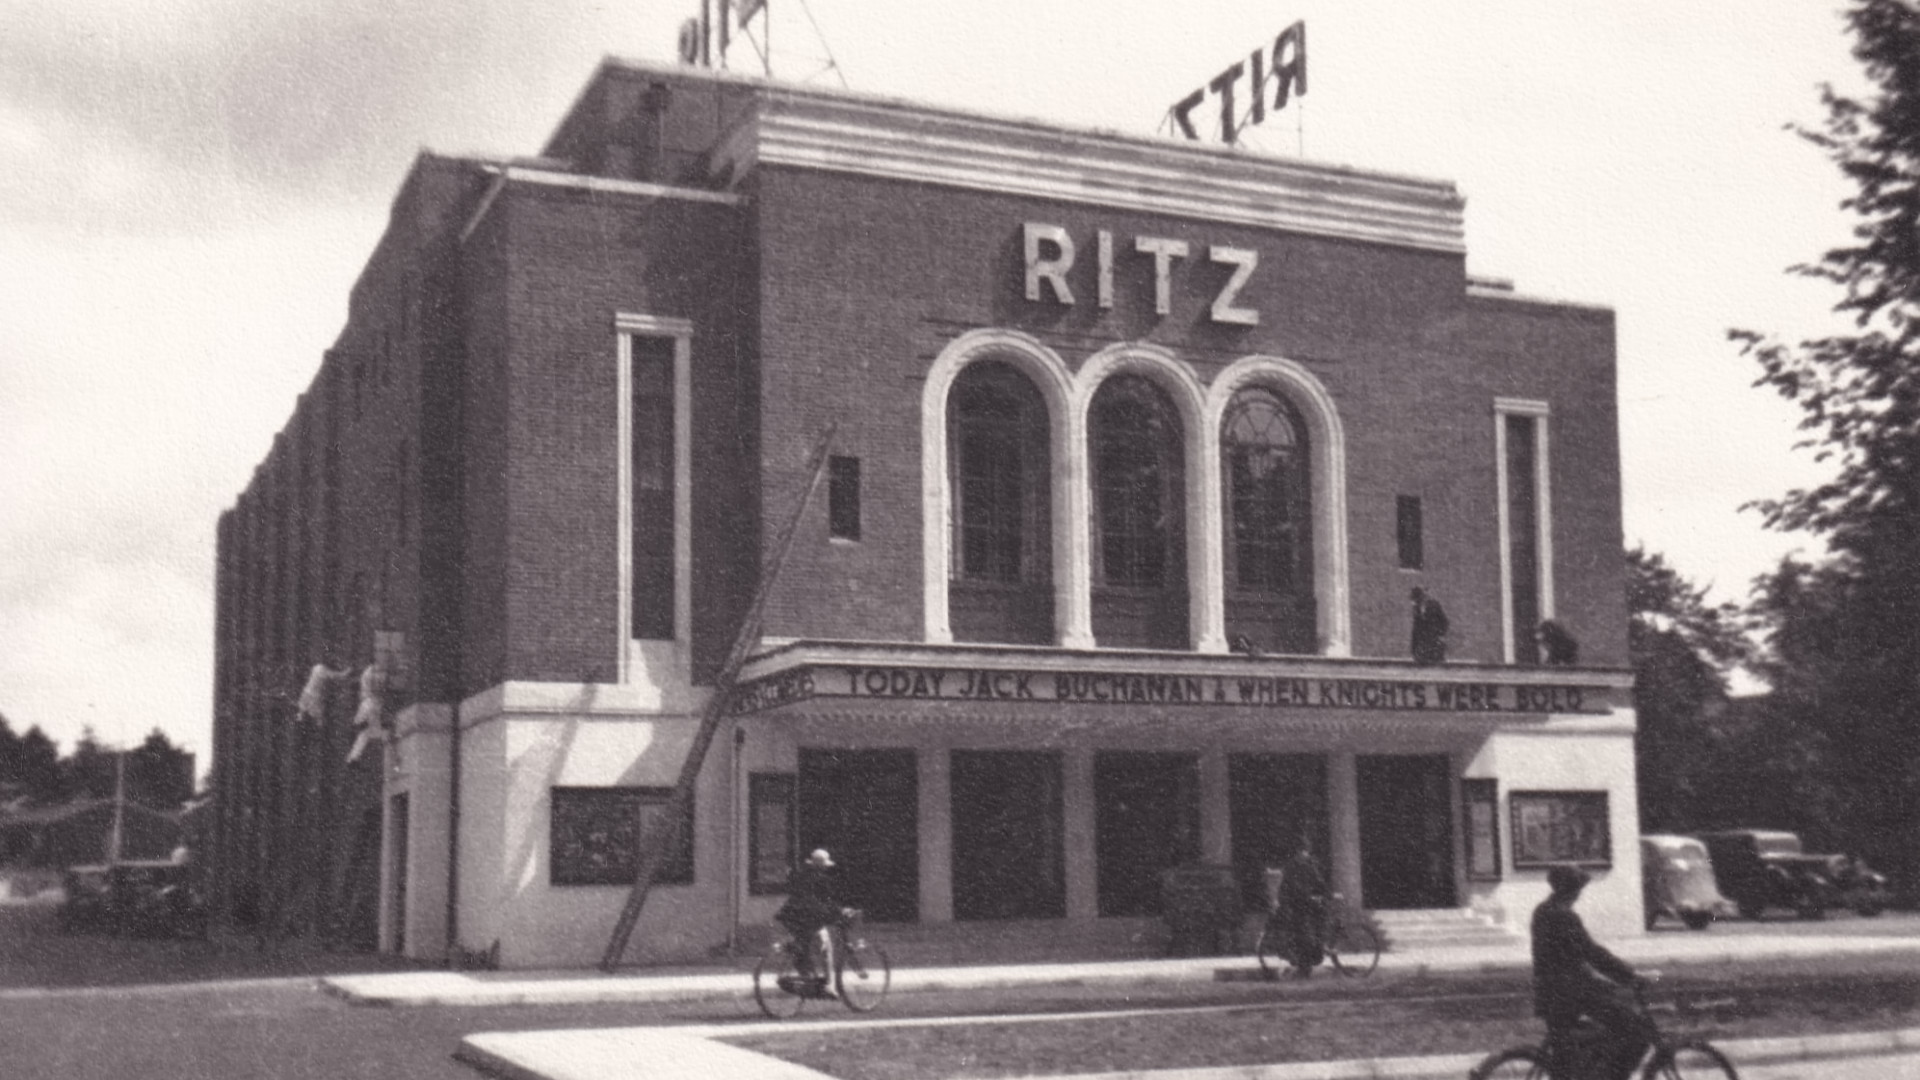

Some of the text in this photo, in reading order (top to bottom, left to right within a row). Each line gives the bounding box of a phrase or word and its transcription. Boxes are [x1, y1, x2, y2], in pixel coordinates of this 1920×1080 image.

[1023, 222, 1260, 325] RITZ
[850, 670, 944, 698] TODAY
[959, 673, 1034, 700] JACK
[1055, 675, 1203, 706] BUCHANAN
[1239, 678, 1308, 706] WHEN
[1321, 682, 1429, 711] KNIGHTS
[1439, 684, 1502, 712] WERE
[1516, 687, 1584, 714] BOLD
